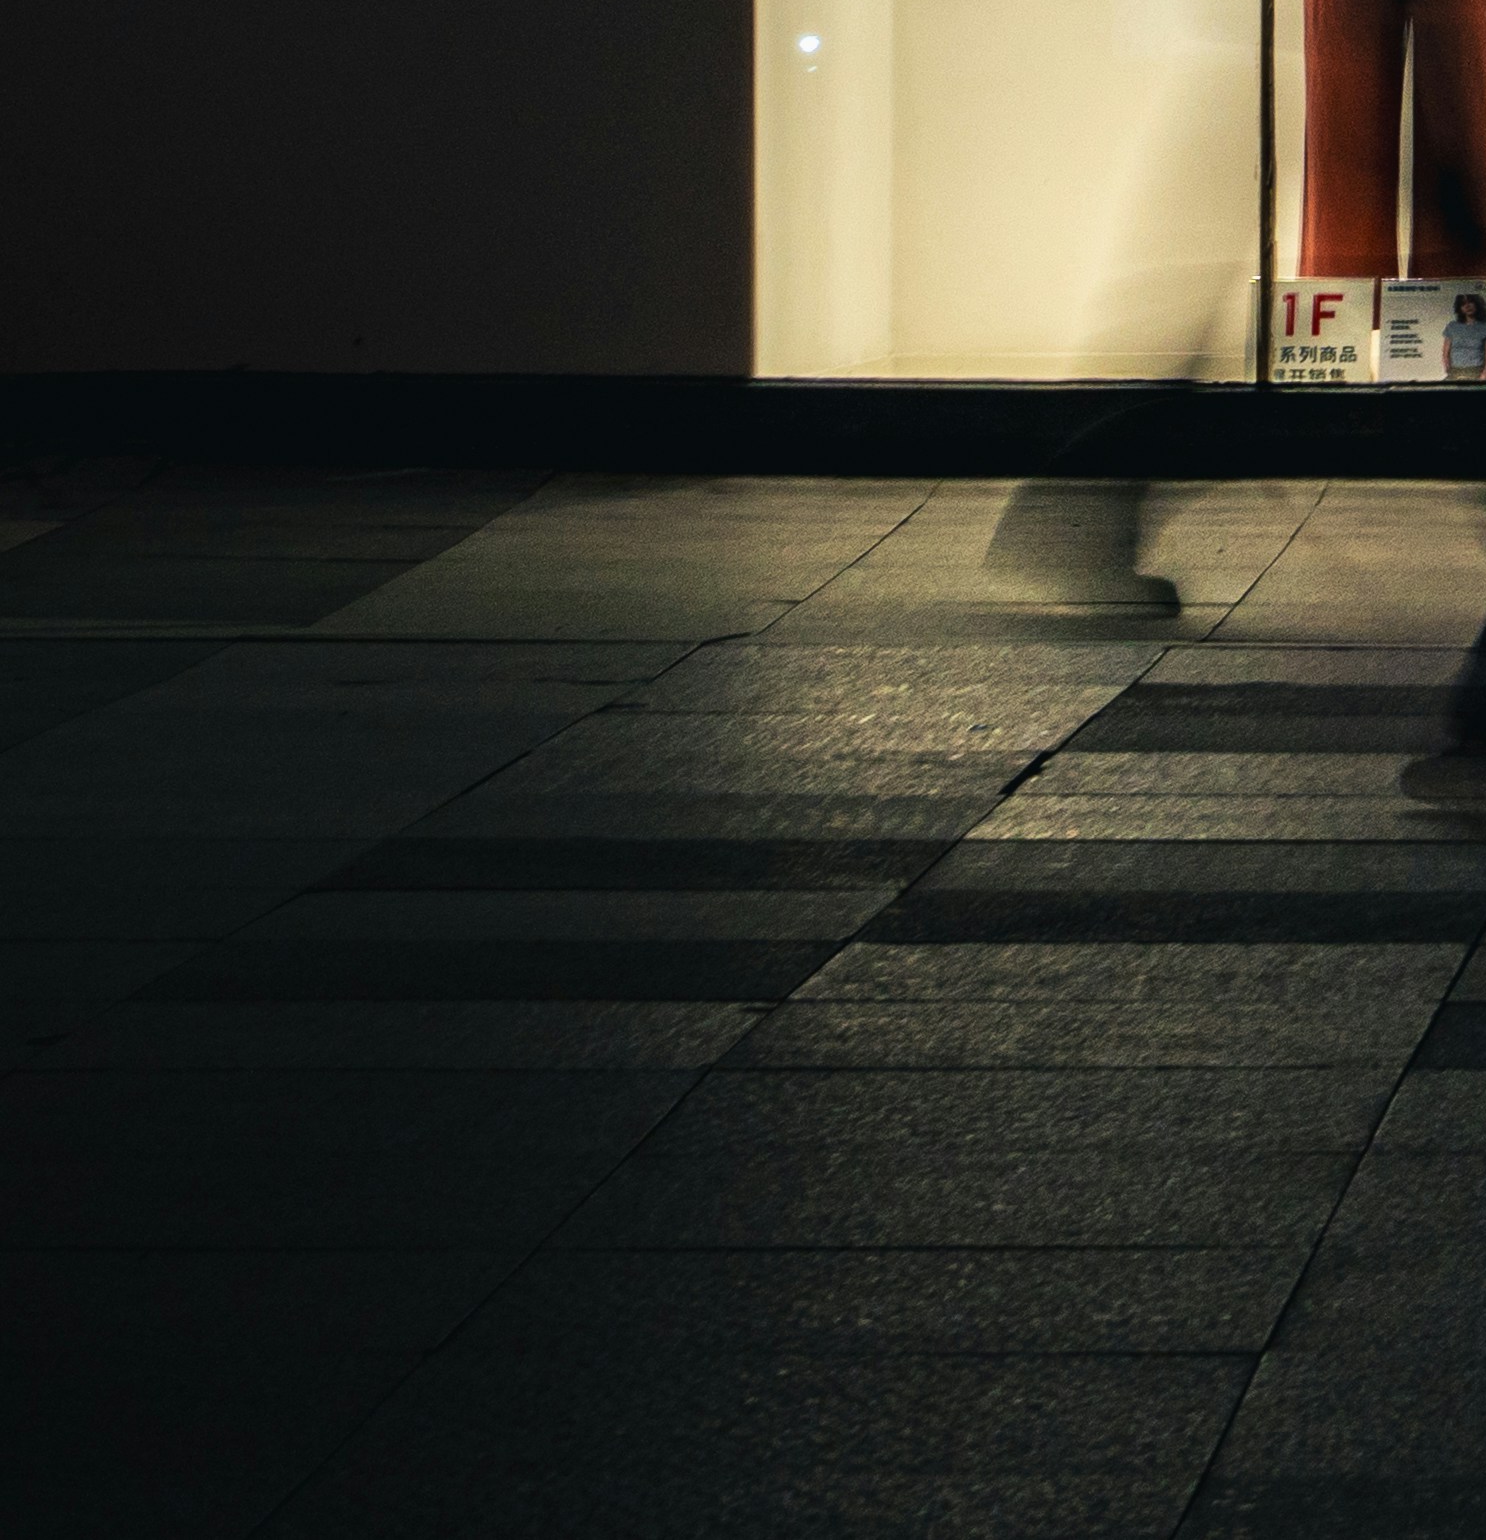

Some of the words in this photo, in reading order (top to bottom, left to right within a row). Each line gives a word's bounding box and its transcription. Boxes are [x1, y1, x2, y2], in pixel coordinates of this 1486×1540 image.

[1283, 293, 1343, 336] 1F
[1273, 345, 1357, 363] 系列商品
